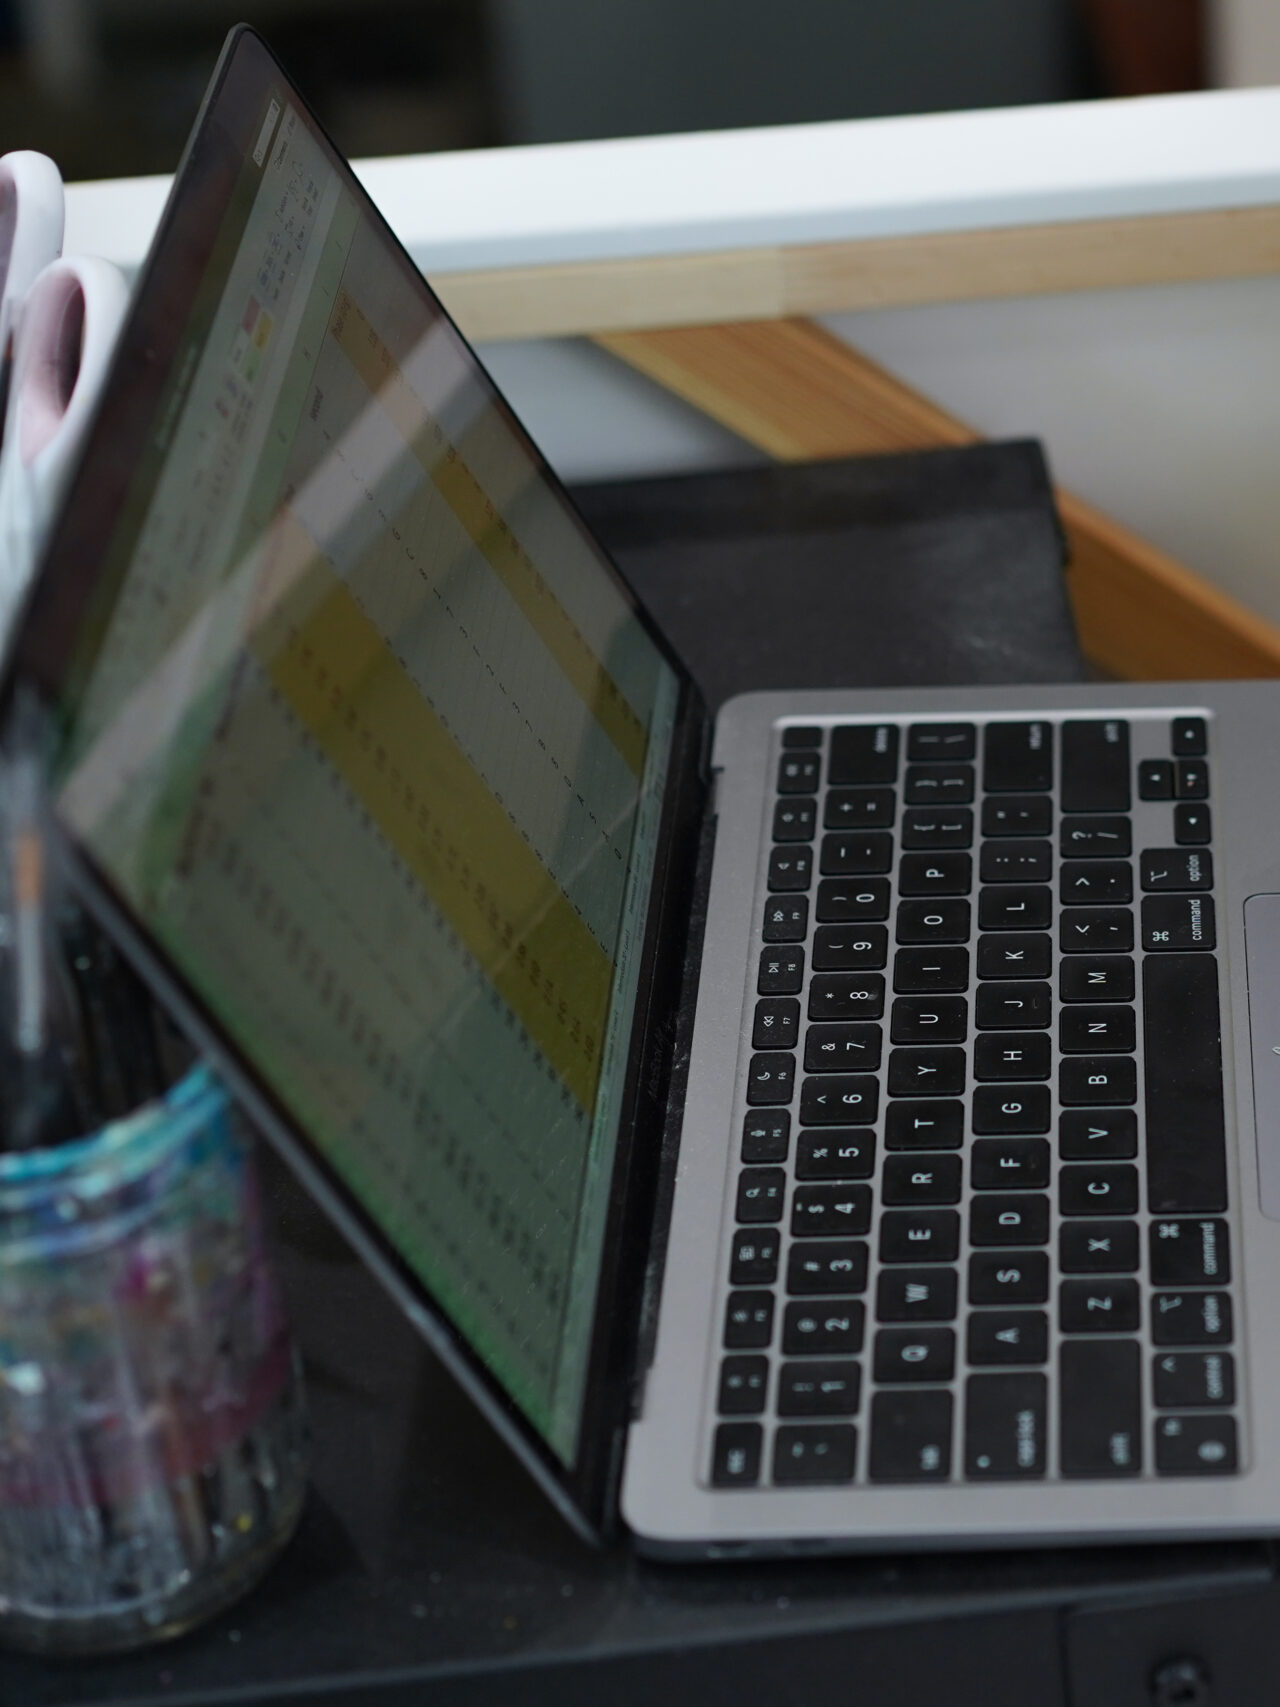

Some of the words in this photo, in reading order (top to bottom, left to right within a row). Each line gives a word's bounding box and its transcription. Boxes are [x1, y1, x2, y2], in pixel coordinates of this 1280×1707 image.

[926, 869, 944, 878] P
[1186, 855, 1202, 881] option
[1006, 902, 1025, 910] L
[1189, 899, 1202, 941] command
[853, 942, 872, 950] 9
[1005, 951, 1024, 959] K
[1088, 972, 1107, 983] M
[850, 991, 868, 1000] 8
[919, 1014, 938, 1023] U
[1088, 1023, 1107, 1033] N
[846, 1041, 865, 1050] 7
[1003, 1051, 1022, 1060] H
[917, 1066, 936, 1075] Y
[1088, 1075, 1107, 1084] B
[842, 1094, 862, 1103] 6
[1002, 1103, 1022, 1113] G
[914, 1119, 934, 1128] T
[1088, 1128, 1108, 1139] V
[838, 1147, 859, 1157] 5
[1000, 1158, 1021, 1167] F
[911, 1173, 932, 1184] R
[1088, 1183, 1110, 1194] C
[834, 1202, 855, 1214] 4
[999, 1212, 1021, 1225] D
[908, 1229, 931, 1240] E
[1088, 1239, 1110, 1251] X
[1200, 1222, 1217, 1275] command
[829, 1259, 853, 1271] 3
[996, 1269, 1020, 1282] S
[906, 1284, 928, 1302] W
[1088, 1297, 1112, 1310] Z
[825, 1318, 849, 1331] 2
[996, 1328, 1018, 1343] A
